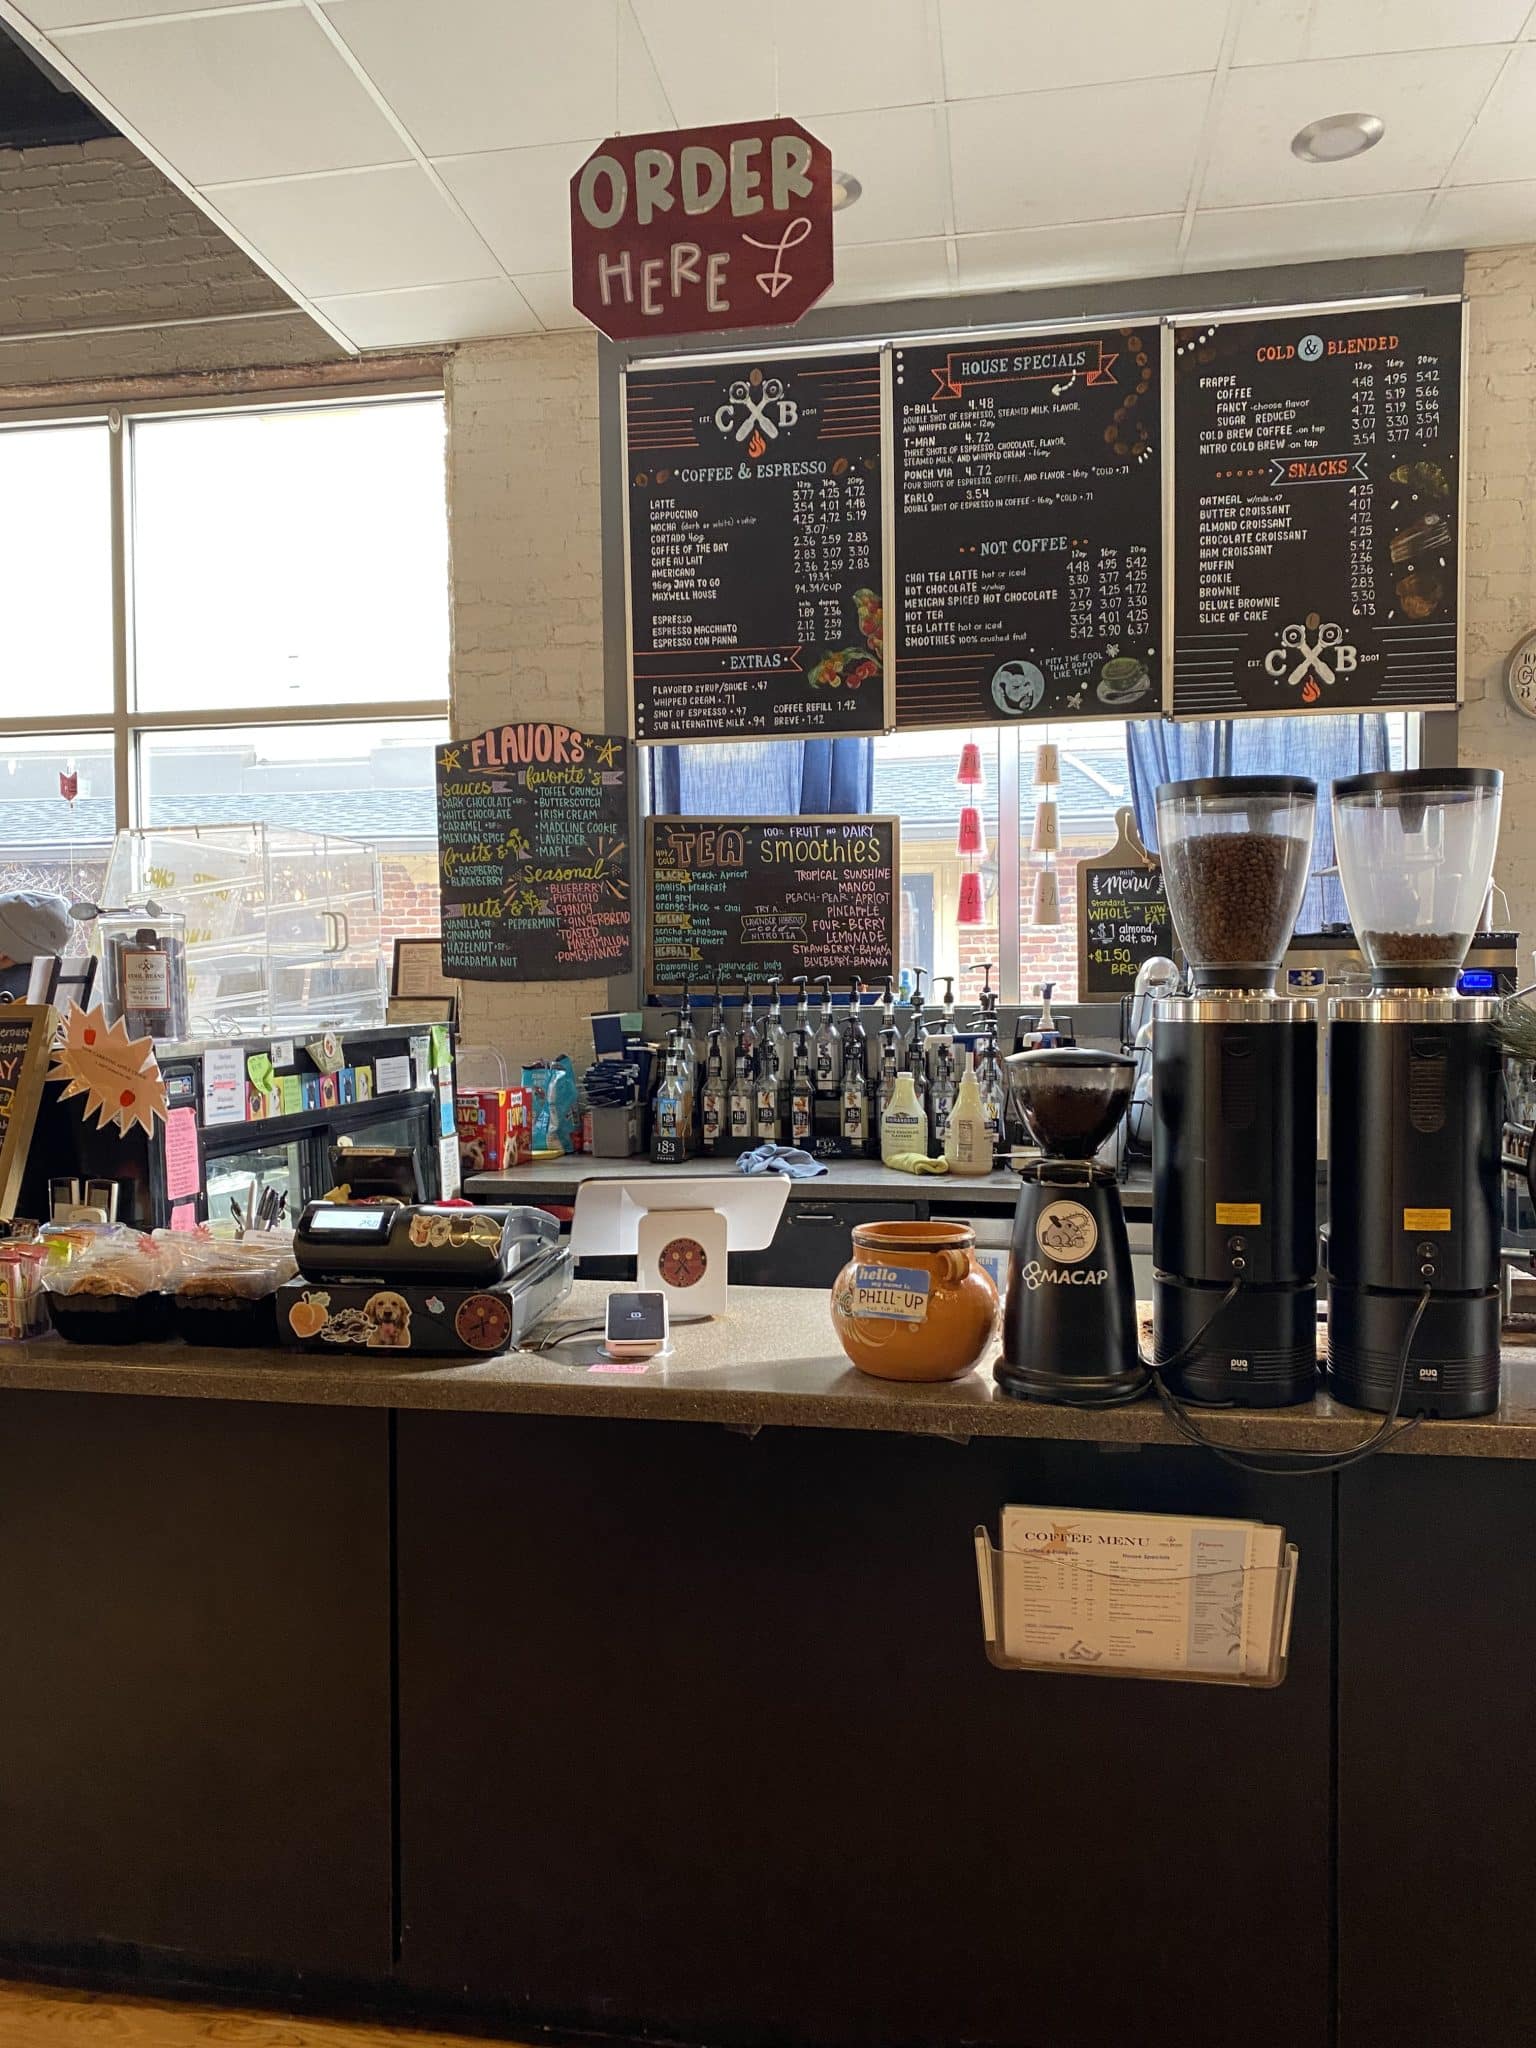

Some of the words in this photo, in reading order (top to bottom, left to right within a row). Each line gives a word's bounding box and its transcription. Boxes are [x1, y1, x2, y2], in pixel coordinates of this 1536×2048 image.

[579, 135, 813, 229] ORDER
[599, 242, 729, 315] HERE
[1257, 346, 1295, 362] COLD
[1304, 340, 1317, 355] &
[1328, 335, 1399, 355] BLENDED
[962, 360, 1008, 375] HOUSE
[1014, 352, 1085, 372] SPECIALS
[1200, 376, 1236, 388] FRAPPE
[1217, 388, 1252, 399] COFFEE
[968, 398, 993, 409] 4.48
[1217, 401, 1247, 414] FANCY
[715, 405, 734, 432] C
[778, 401, 798, 427] B
[1218, 415, 1246, 426] SUGAR
[1255, 410, 1296, 424] REDUCED
[1200, 430, 1223, 441] COLD
[1227, 428, 1253, 440] BREW
[1257, 425, 1292, 436] COFFEE
[904, 437, 935, 447] T-MAN
[965, 432, 991, 443] 4.72
[1200, 443, 1228, 454] NITRO
[1231, 441, 1254, 452] COLD
[1257, 440, 1285, 451] BREW
[682, 467, 733, 482] COFFEE
[738, 463, 751, 479] &
[757, 461, 827, 478] ESPRESSO
[904, 469, 934, 480] PONCH
[937, 468, 953, 478] VIA
[965, 465, 992, 476] 4.72
[1289, 459, 1348, 478] SNACKS
[904, 493, 933, 503] KARLO
[966, 489, 989, 500] 3.54
[1200, 495, 1242, 505] OATMEAL
[650, 499, 675, 509] LATTE
[650, 510, 698, 520] CAPPUCCINO
[1200, 508, 1236, 519] BUTTER
[1239, 504, 1290, 517] CROISSANT
[651, 523, 676, 532] MOCHA
[1200, 521, 1237, 533] ALMOND
[1240, 517, 1292, 530] CROISSANT
[651, 534, 686, 544] CORTADO
[1200, 533, 1252, 545] CHOCOLATE
[1256, 530, 1307, 542] CROISSANT
[652, 545, 680, 555] COFFEE
[696, 544, 710, 552] THE
[714, 543, 728, 552] DAY
[981, 541, 1007, 556] NOT
[1013, 537, 1068, 553] COFFEE
[1200, 547, 1219, 558] HAM
[1222, 545, 1273, 557] CROISSANT
[686, 556, 703, 565] LAIT
[1200, 560, 1234, 571] MUFFIN
[652, 568, 695, 578] AMERICANO
[906, 573, 925, 582] CHAI
[929, 572, 946, 581] TEA
[950, 570, 978, 581] LATTE
[1009, 569, 1026, 577] iced
[1200, 573, 1232, 584] COOKIE
[674, 580, 694, 589] JAVA
[905, 586, 922, 595] HOT
[926, 582, 977, 594] CHOCOLATE
[652, 591, 690, 601] MAXWELL
[693, 590, 716, 599] HOUSE
[1200, 586, 1240, 597] BROWNIE
[905, 597, 944, 609] MEXICAN
[947, 595, 980, 606] SPICED
[983, 593, 1000, 604] HOT
[1004, 590, 1058, 601] CHOCOLATE
[1200, 599, 1234, 611] DELUXE
[1238, 597, 1280, 608] BROWNIE
[653, 616, 692, 625] ESPRESSO
[905, 611, 922, 621] HOT
[926, 610, 944, 620] TEA
[1200, 613, 1226, 623] SLICE
[1244, 610, 1268, 621] CAKE
[653, 627, 692, 636] ESPRESSO
[694, 624, 737, 635] MACCHIATO
[905, 624, 922, 633] TEA
[926, 622, 955, 632] LATTE
[985, 621, 1002, 629] iced
[653, 637, 692, 648] ESPRESSO
[694, 637, 709, 645] CON
[712, 636, 737, 645] PANNA
[905, 635, 955, 647] SMOOTHIES
[730, 654, 780, 670] EXTRAS
[1265, 649, 1287, 676] C
[1335, 646, 1357, 672] B
[1361, 654, 1379, 663] 2001
[1054, 671, 1071, 679] LIKE
[653, 685, 692, 695] FLAVORED
[695, 681, 748, 693] SYRUP/SAUCE
[653, 696, 687, 706] WHIPPED
[690, 695, 716, 705] CREAM
[654, 708, 673, 719] SHOT
[688, 707, 727, 717] ESPRESSO
[774, 704, 803, 713] COFFEE
[806, 702, 832, 712] REFILL
[654, 720, 669, 730] SUB
[671, 718, 723, 729] ALTERNATIVE
[726, 717, 745, 727] MILK
[774, 716, 799, 726] BREVE
[471, 724, 585, 767] FLAVORS
[442, 783, 493, 796] sauces
[442, 799, 464, 808] DARK
[466, 797, 512, 807] CHOCOLATE
[540, 798, 600, 807] BUTTERSCOTCH
[442, 810, 466, 819] WHITE
[468, 809, 512, 818] CHOCOLATE
[540, 810, 564, 819] IRISH
[567, 810, 597, 819] CREAM
[443, 821, 482, 831] CARAMEL
[587, 824, 617, 834] COOKIE
[790, 826, 819, 838] FRUIT
[842, 825, 875, 838] DAIRY
[443, 834, 481, 844] MEXICAN
[483, 833, 505, 842] SPICE
[540, 834, 586, 845] LAVENDER
[540, 846, 570, 857] MAPLE
[668, 830, 744, 868] TEA
[442, 843, 493, 878] fruits
[524, 858, 608, 883] Seasonal
[795, 870, 838, 881] TROPICAL
[844, 869, 891, 880] SUNSHINE
[451, 876, 503, 886] BLACKBERRY
[839, 881, 875, 892] MANGO
[462, 899, 501, 918] nuts
[827, 905, 879, 918] PINEAPPLE
[1088, 907, 1132, 920] WHOLE
[446, 919, 480, 929] VANILLA
[508, 918, 561, 930] PEPPERMINT
[1145, 914, 1167, 925] FAT
[447, 930, 491, 940] CINNAMON
[827, 931, 886, 943] LEMONADE
[1141, 935, 1157, 946] soy
[447, 942, 492, 953] HAZELNUT
[447, 956, 497, 966] MACADAMIA
[501, 957, 517, 967] NUT
[657, 1140, 675, 1154] 183
[860, 1269, 897, 1281] hello
[1040, 1269, 1108, 1286] MACAP
[1025, 1532, 1093, 1544] COFFEE
[1098, 1536, 1150, 1547] MENU
